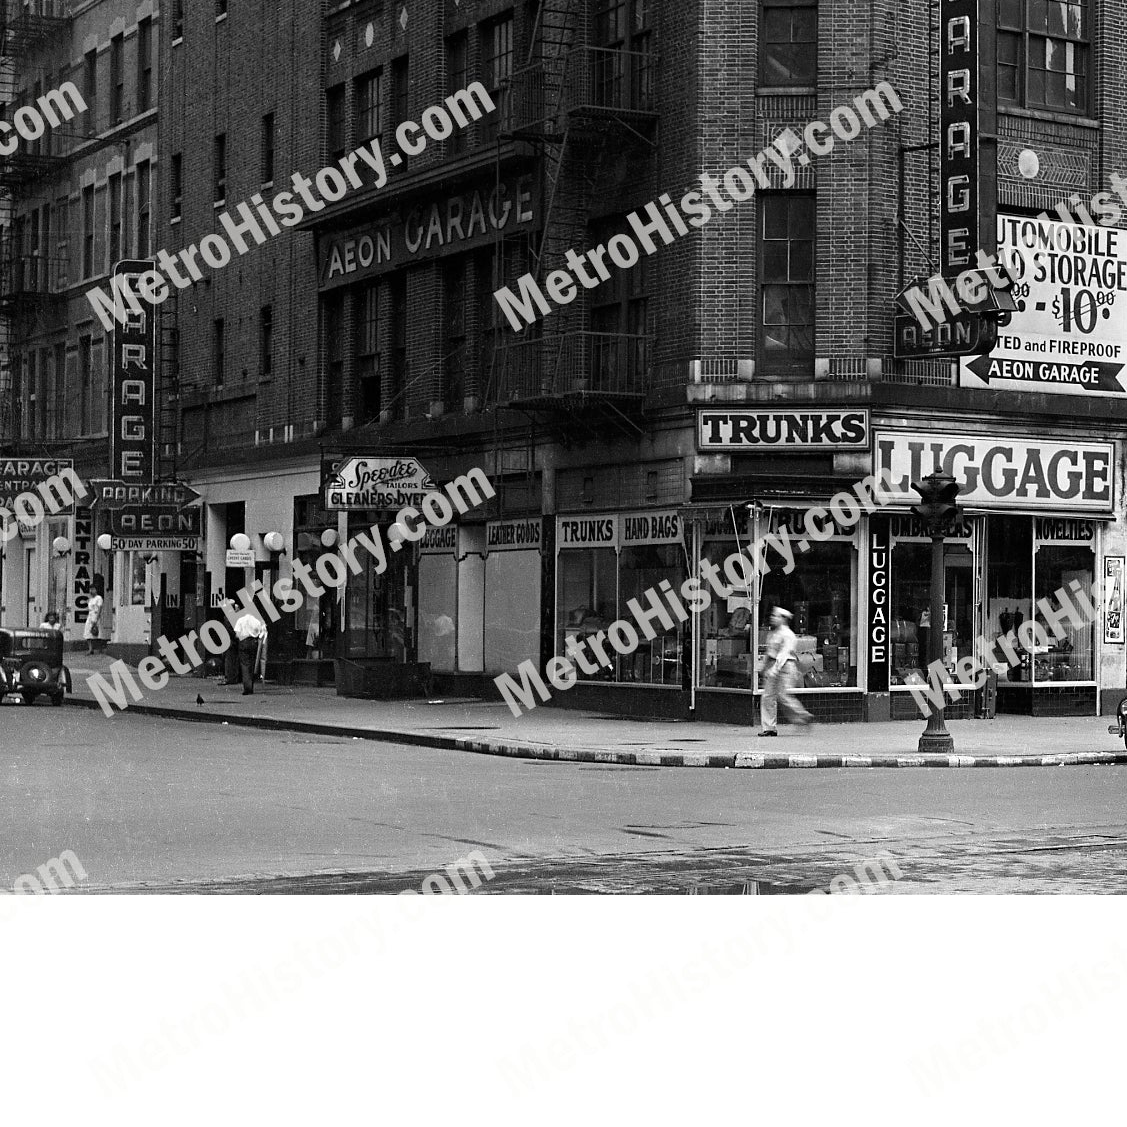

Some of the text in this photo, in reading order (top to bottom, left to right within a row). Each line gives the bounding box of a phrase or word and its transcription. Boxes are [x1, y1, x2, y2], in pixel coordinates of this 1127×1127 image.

[329, 175, 533, 279] AEON GARAGE
[997, 218, 1118, 257] UTOMOBILE
[1034, 252, 1127, 291] STORAGE
[997, 336, 1121, 358] TED and FIREPROOF
[121, 273, 147, 476] GARAGE
[988, 360, 1099, 384] AEON GARAGE
[702, 414, 866, 444] TRUNKS
[878, 440, 1110, 501] LUGGAGE
[102, 486, 186, 503] PARKING
[331, 491, 393, 506] CLEANERS
[121, 514, 193, 531] AEON
[561, 519, 613, 542] TRUNKS
[625, 514, 679, 540] HAND BAGS
[1035, 519, 1093, 540] NOVELTIES
[128, 539, 143, 548] DAY
[146, 539, 181, 548] PARKING
[420, 526, 456, 548] LUGGAGE
[488, 523, 540, 546] LEATHER GOODS
[75, 507, 91, 623] ENTRANCE
[166, 594, 178, 607] IN
[871, 533, 886, 663] LUGGAGE
